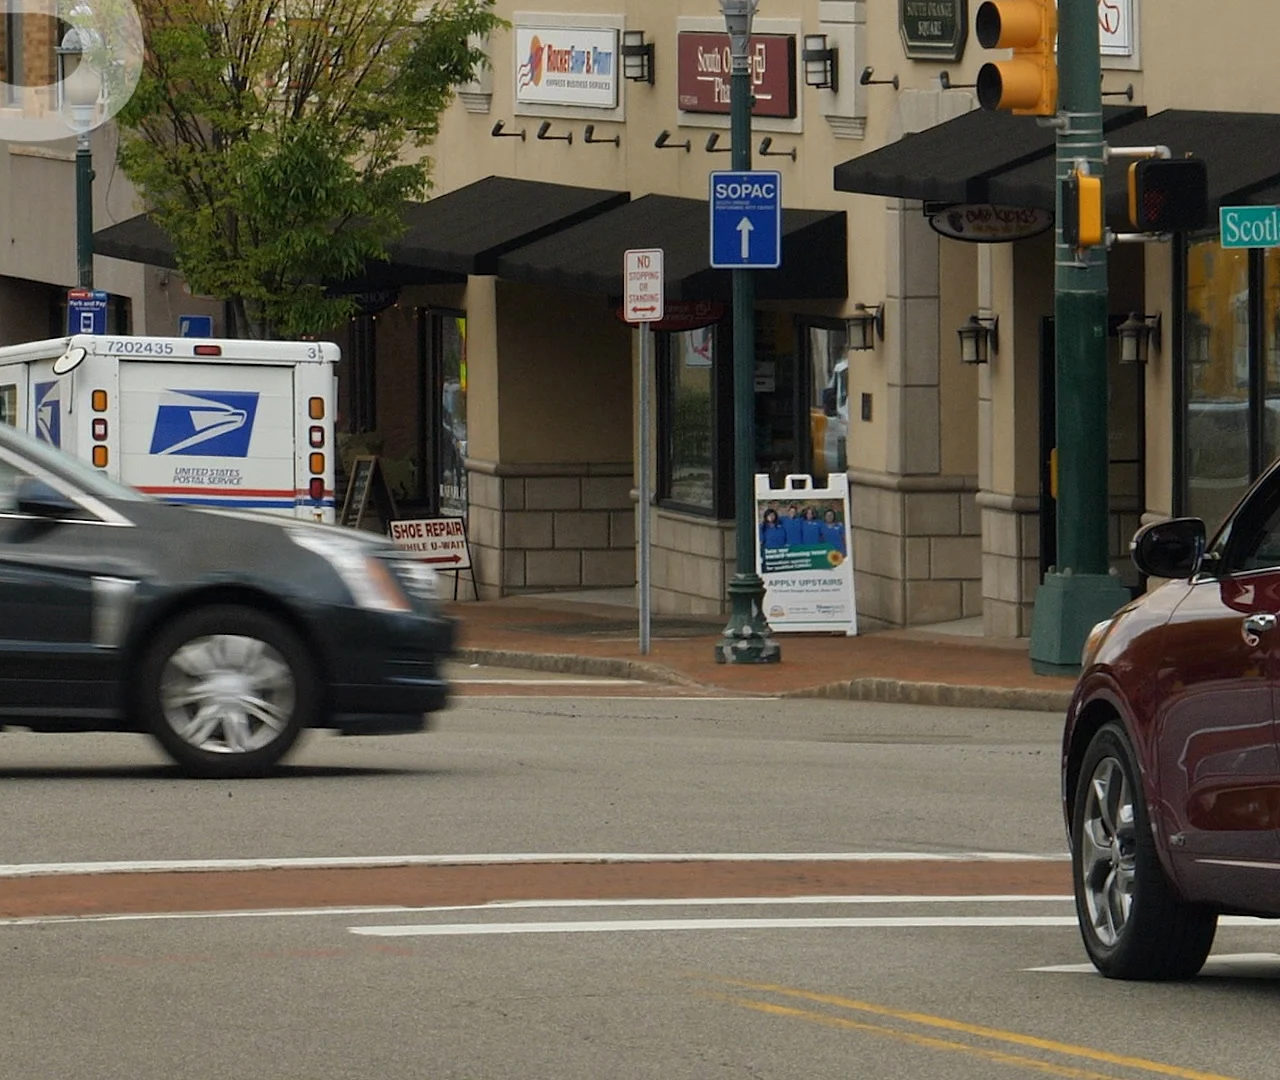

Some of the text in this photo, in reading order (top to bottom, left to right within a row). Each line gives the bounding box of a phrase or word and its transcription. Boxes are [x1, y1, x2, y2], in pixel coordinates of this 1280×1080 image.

[917, 20, 942, 37] SQUARE
[697, 45, 722, 73] South
[715, 183, 775, 199] SOPAC
[1225, 211, 1280, 242] Scotl
[637, 255, 651, 269] NO
[628, 271, 660, 282] STOPPING
[639, 282, 649, 292] OR
[628, 293, 660, 304] STANDING
[106, 340, 174, 355] 7202435
[174, 466, 241, 477] UNITED STATES
[172, 475, 243, 486] POSTAL SERVICE
[392, 521, 463, 539] SHOE REPAIR
[431, 540, 465, 551] U-WAIT
[768, 578, 843, 587] APPLY UPSTAIRS
